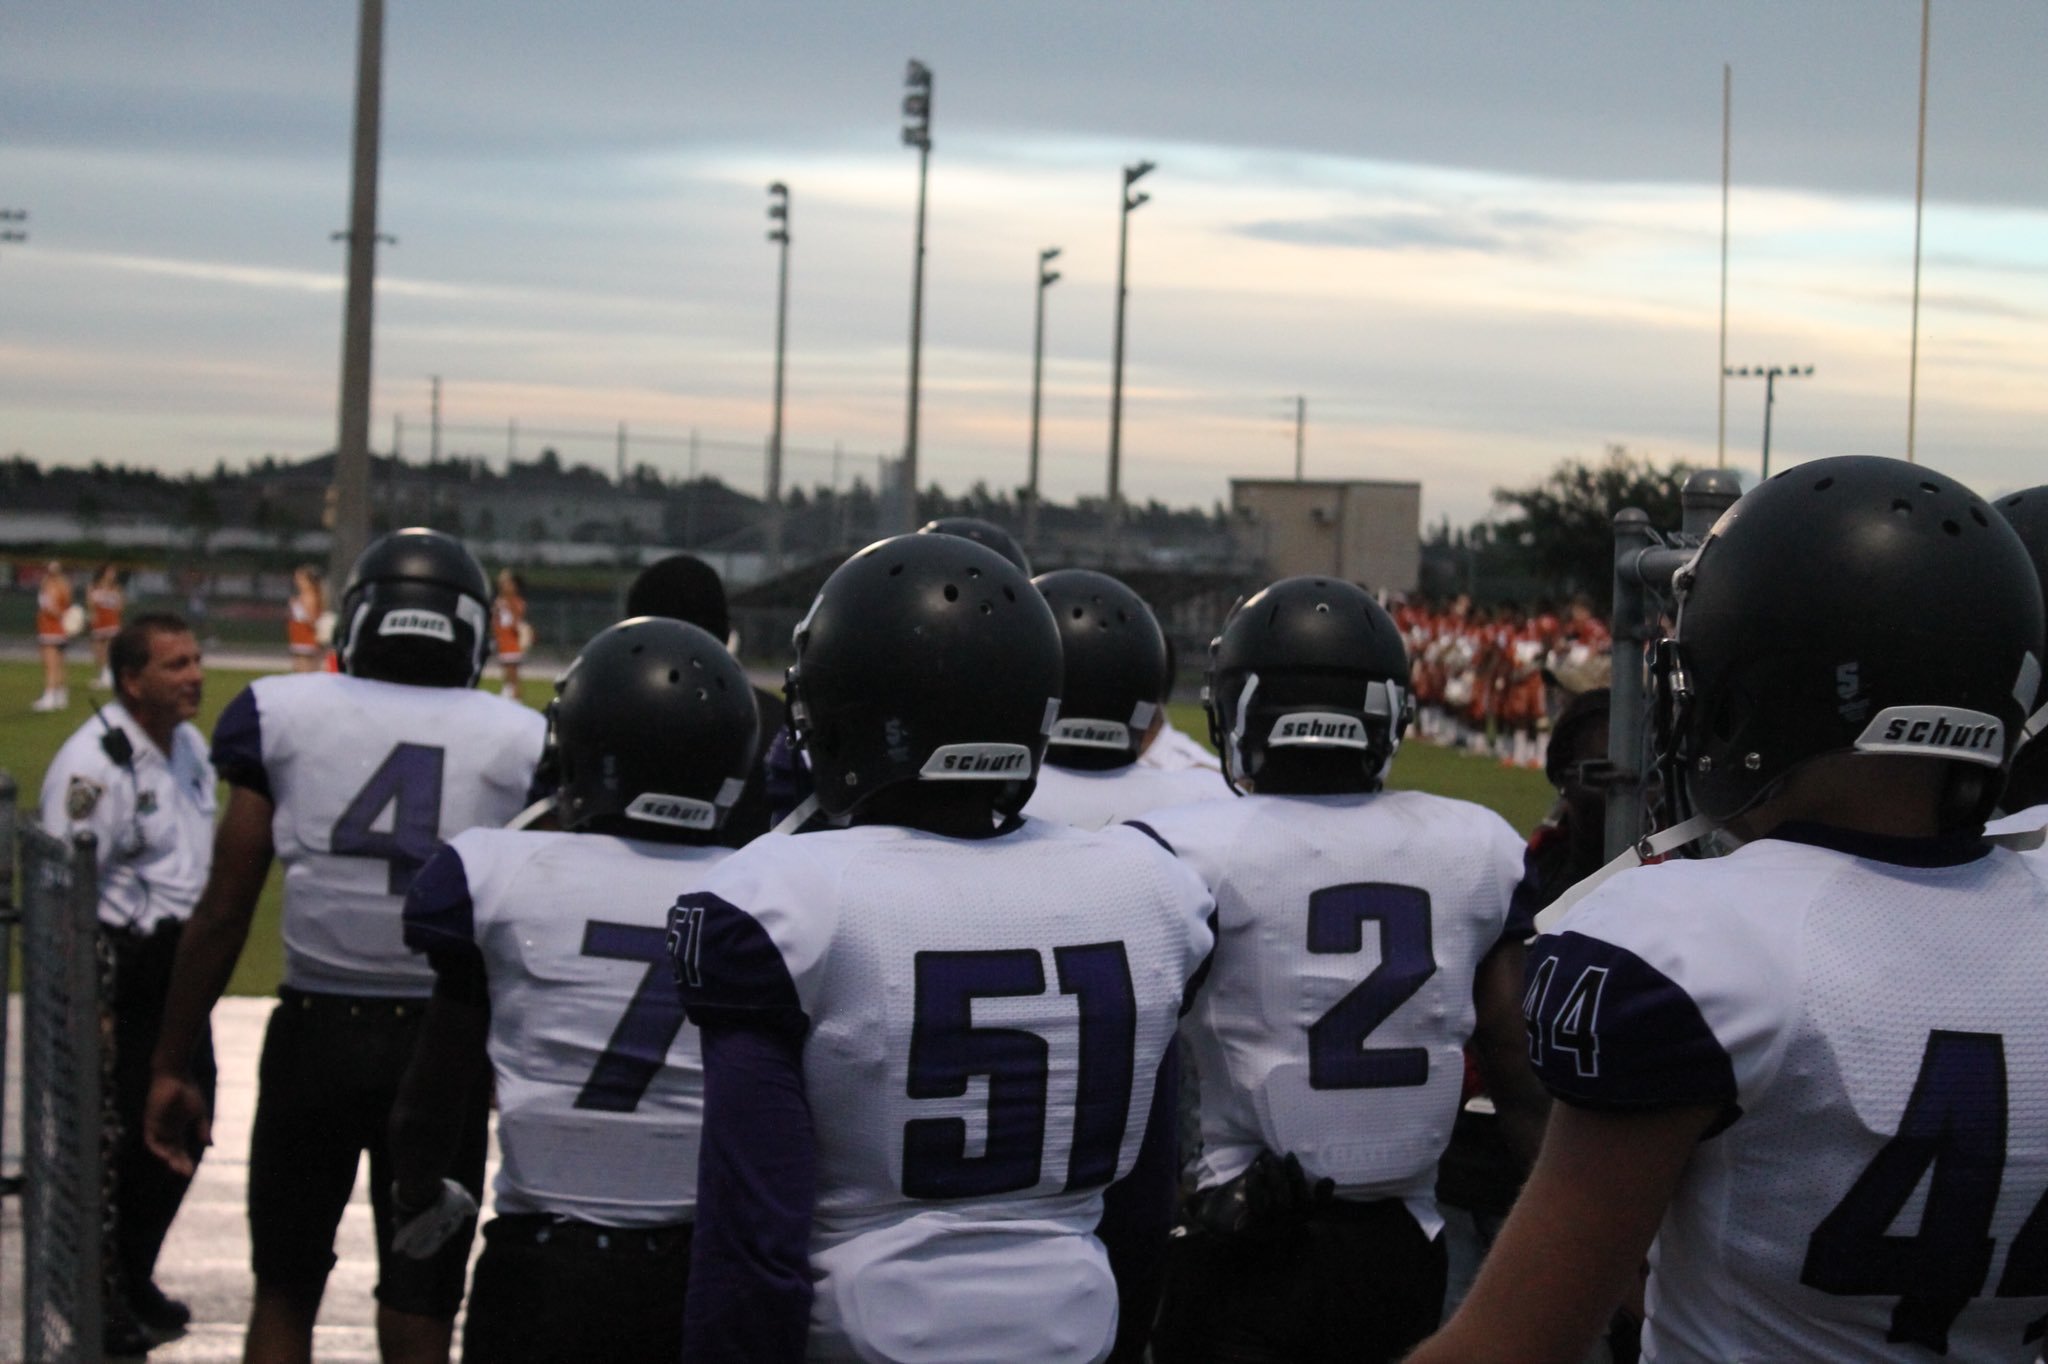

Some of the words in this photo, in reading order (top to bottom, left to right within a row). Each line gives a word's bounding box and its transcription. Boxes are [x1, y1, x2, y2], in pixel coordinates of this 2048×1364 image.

[943, 753, 1025, 771] schutt
[1282, 719, 1357, 738] schutt
[1885, 717, 1997, 748] schutt
[330, 742, 445, 895] 4
[573, 919, 688, 1113] 7
[1307, 881, 1437, 1090] 2
[1522, 955, 1609, 1077] 44
[902, 940, 1137, 1200] 51
